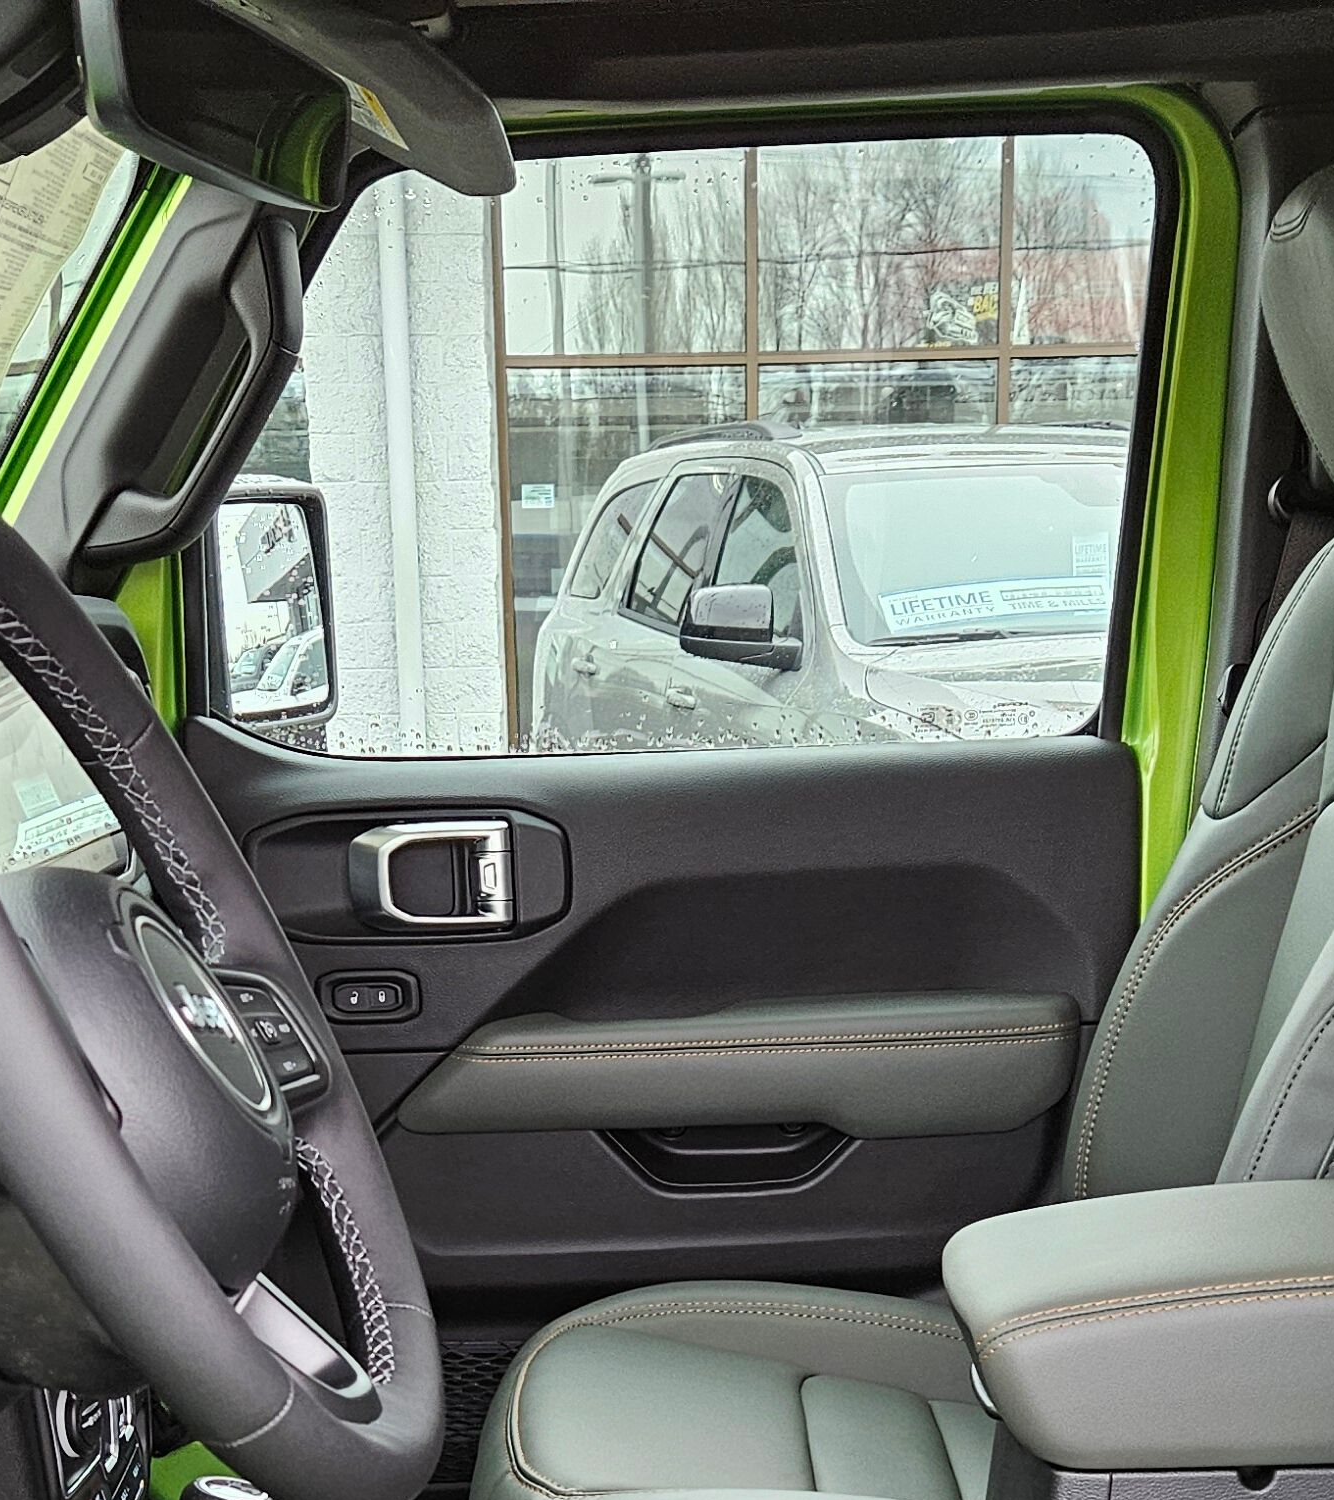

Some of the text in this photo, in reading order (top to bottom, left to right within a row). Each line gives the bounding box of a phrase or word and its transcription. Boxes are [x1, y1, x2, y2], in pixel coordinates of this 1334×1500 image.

[890, 590, 993, 616] LIFETIME
[1008, 600, 1044, 610] TIME
[895, 605, 995, 626] WARRANTY
